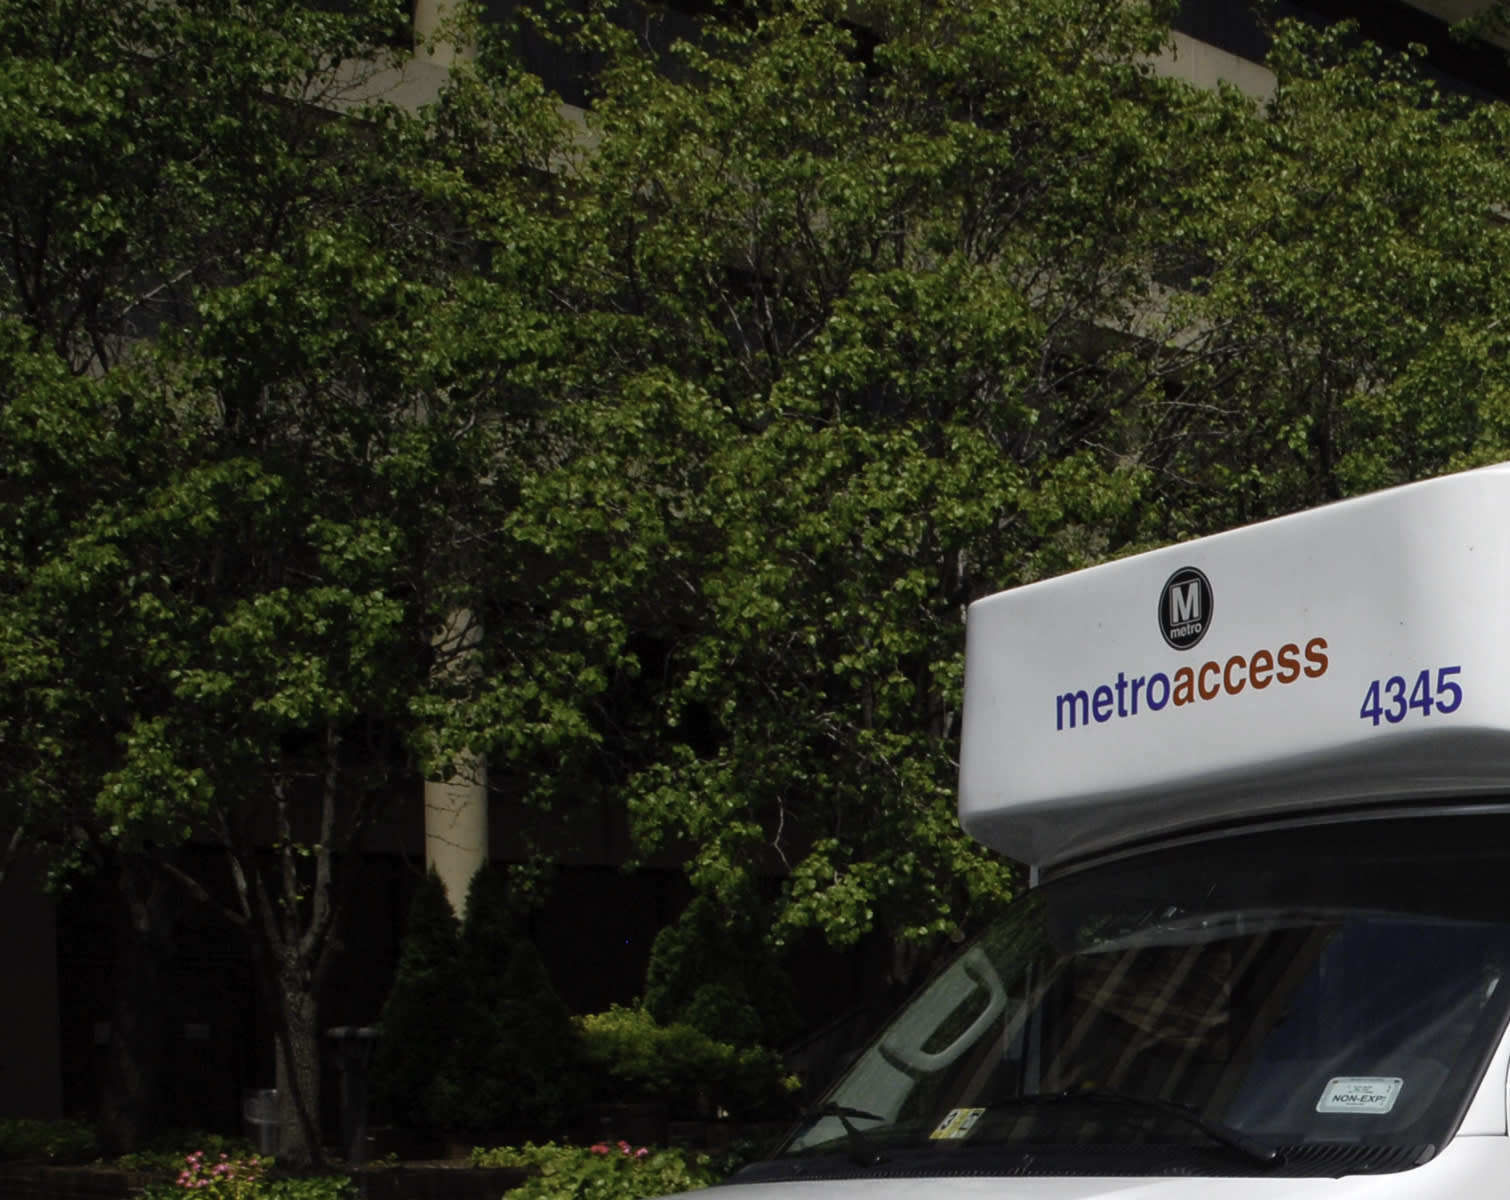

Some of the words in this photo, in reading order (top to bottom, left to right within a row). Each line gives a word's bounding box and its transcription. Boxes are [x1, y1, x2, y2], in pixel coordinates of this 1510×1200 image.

[1170, 622, 1202, 639] metro
[1055, 636, 1329, 731] metroaccess
[1359, 665, 1463, 726] 4345
